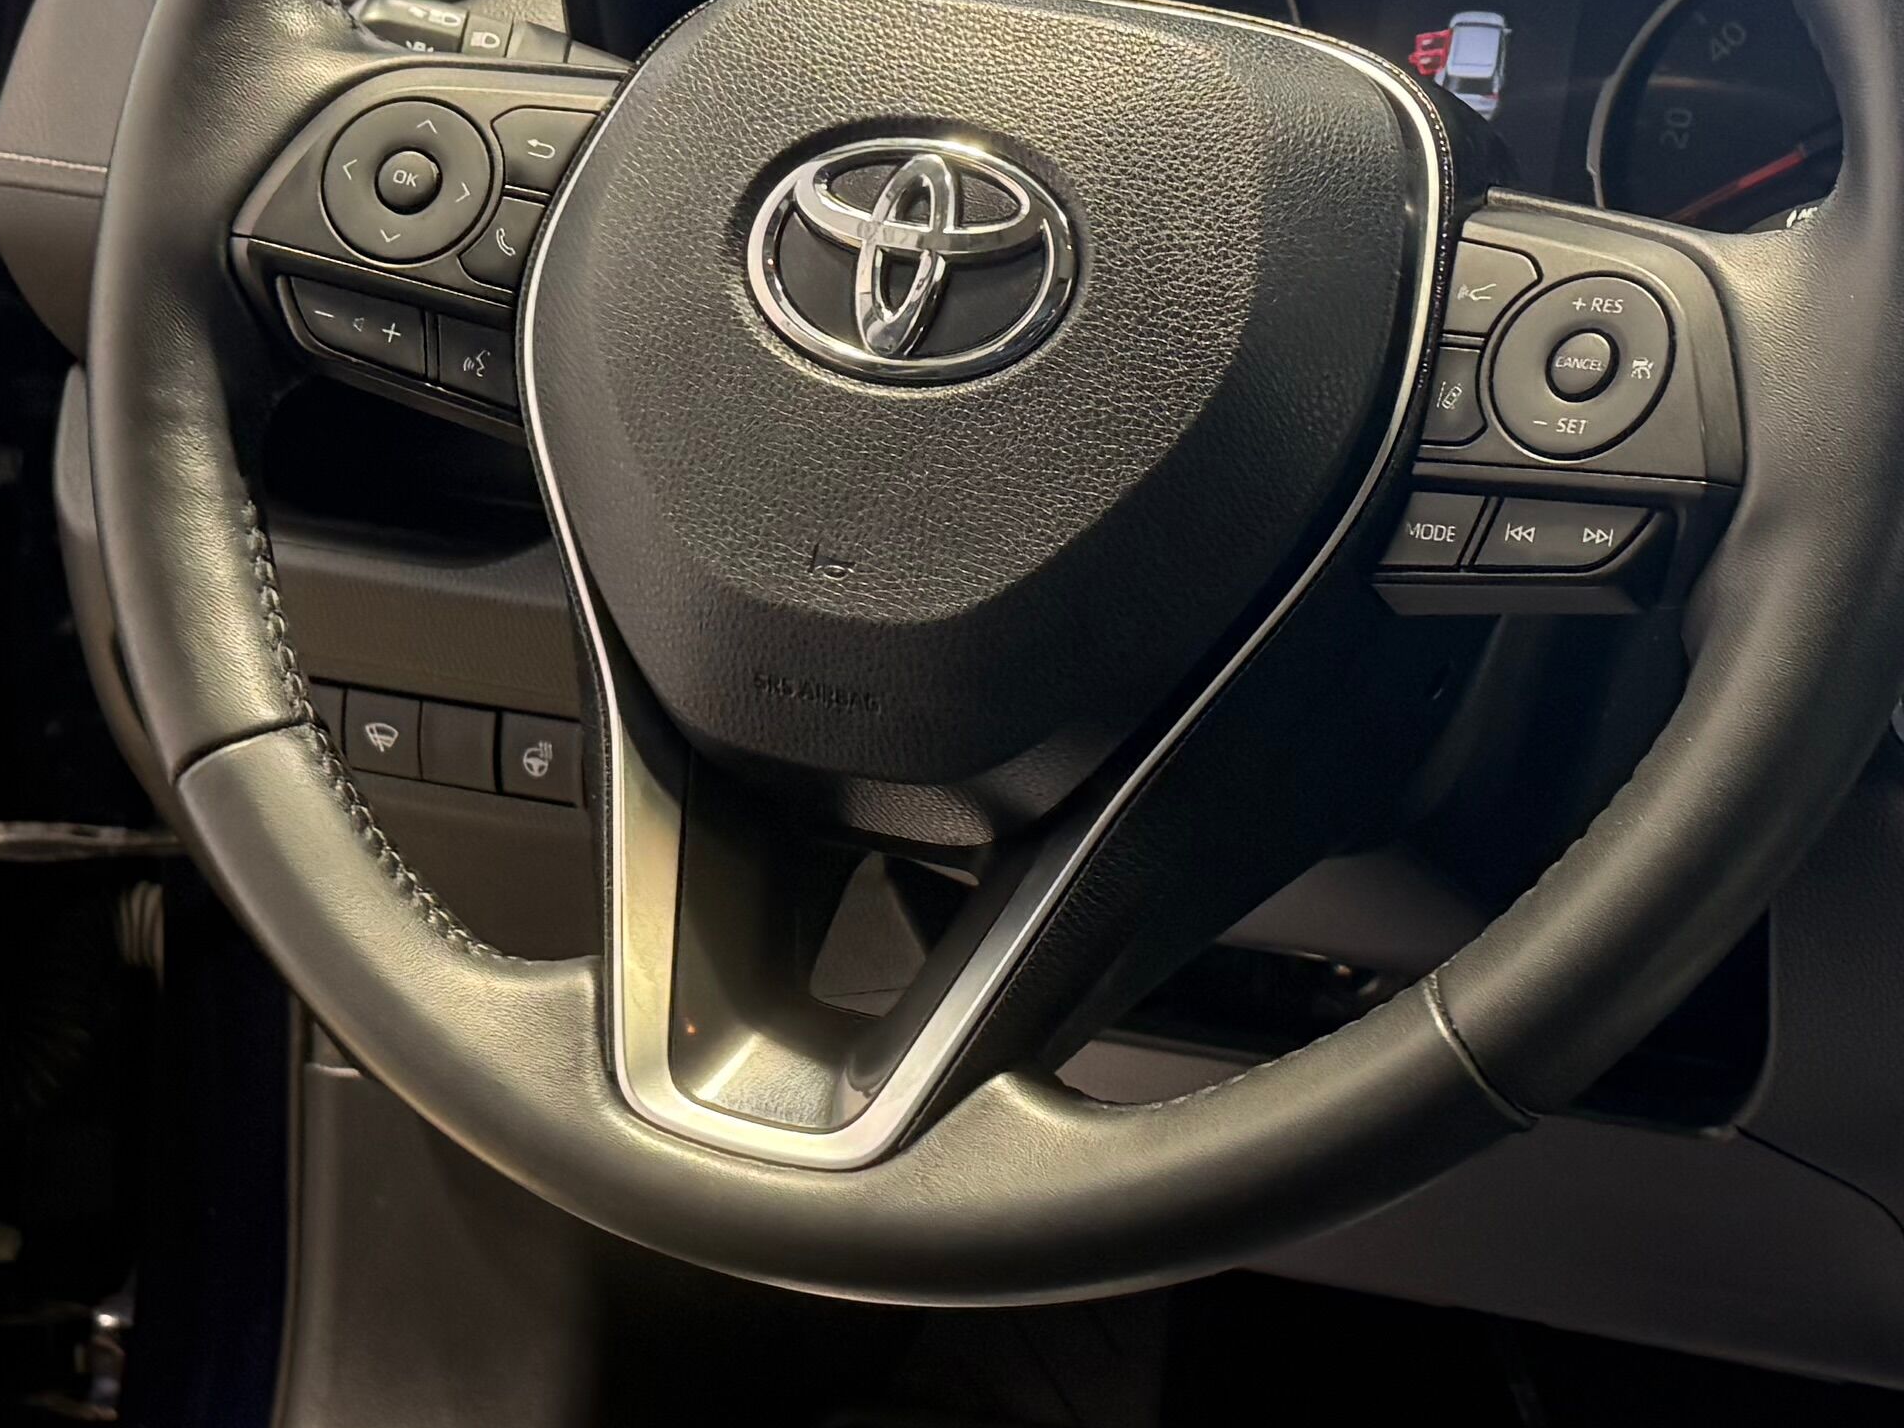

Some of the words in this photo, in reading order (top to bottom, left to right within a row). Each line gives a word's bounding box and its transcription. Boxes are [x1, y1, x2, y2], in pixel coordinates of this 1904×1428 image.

[393, 169, 419, 188] OK
[1589, 295, 1624, 315] RES
[1555, 354, 1605, 373] CANCEL
[1555, 415, 1587, 436] SET
[1406, 521, 1457, 544] MODE
